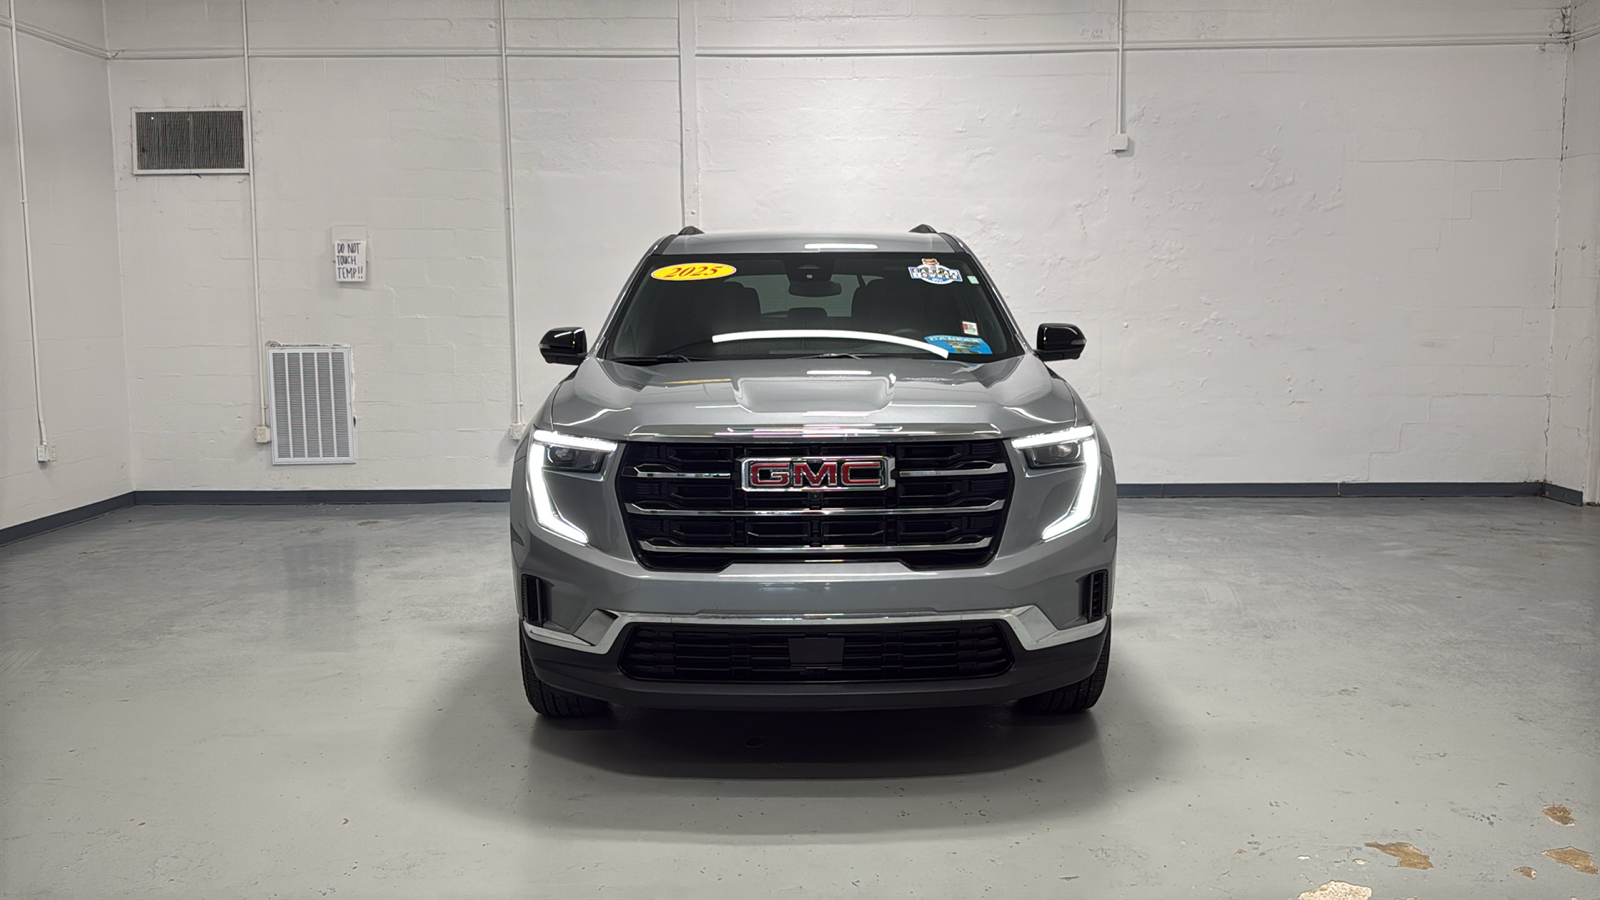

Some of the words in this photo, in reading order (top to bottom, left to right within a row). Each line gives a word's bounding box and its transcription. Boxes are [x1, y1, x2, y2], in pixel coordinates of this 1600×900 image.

[337, 243, 345, 254] DO
[347, 243, 361, 254] NOT
[337, 255, 356, 265] TOUCH
[338, 266, 363, 279] TEMP!!
[663, 266, 723, 278] 2025
[750, 462, 882, 487] GMC
